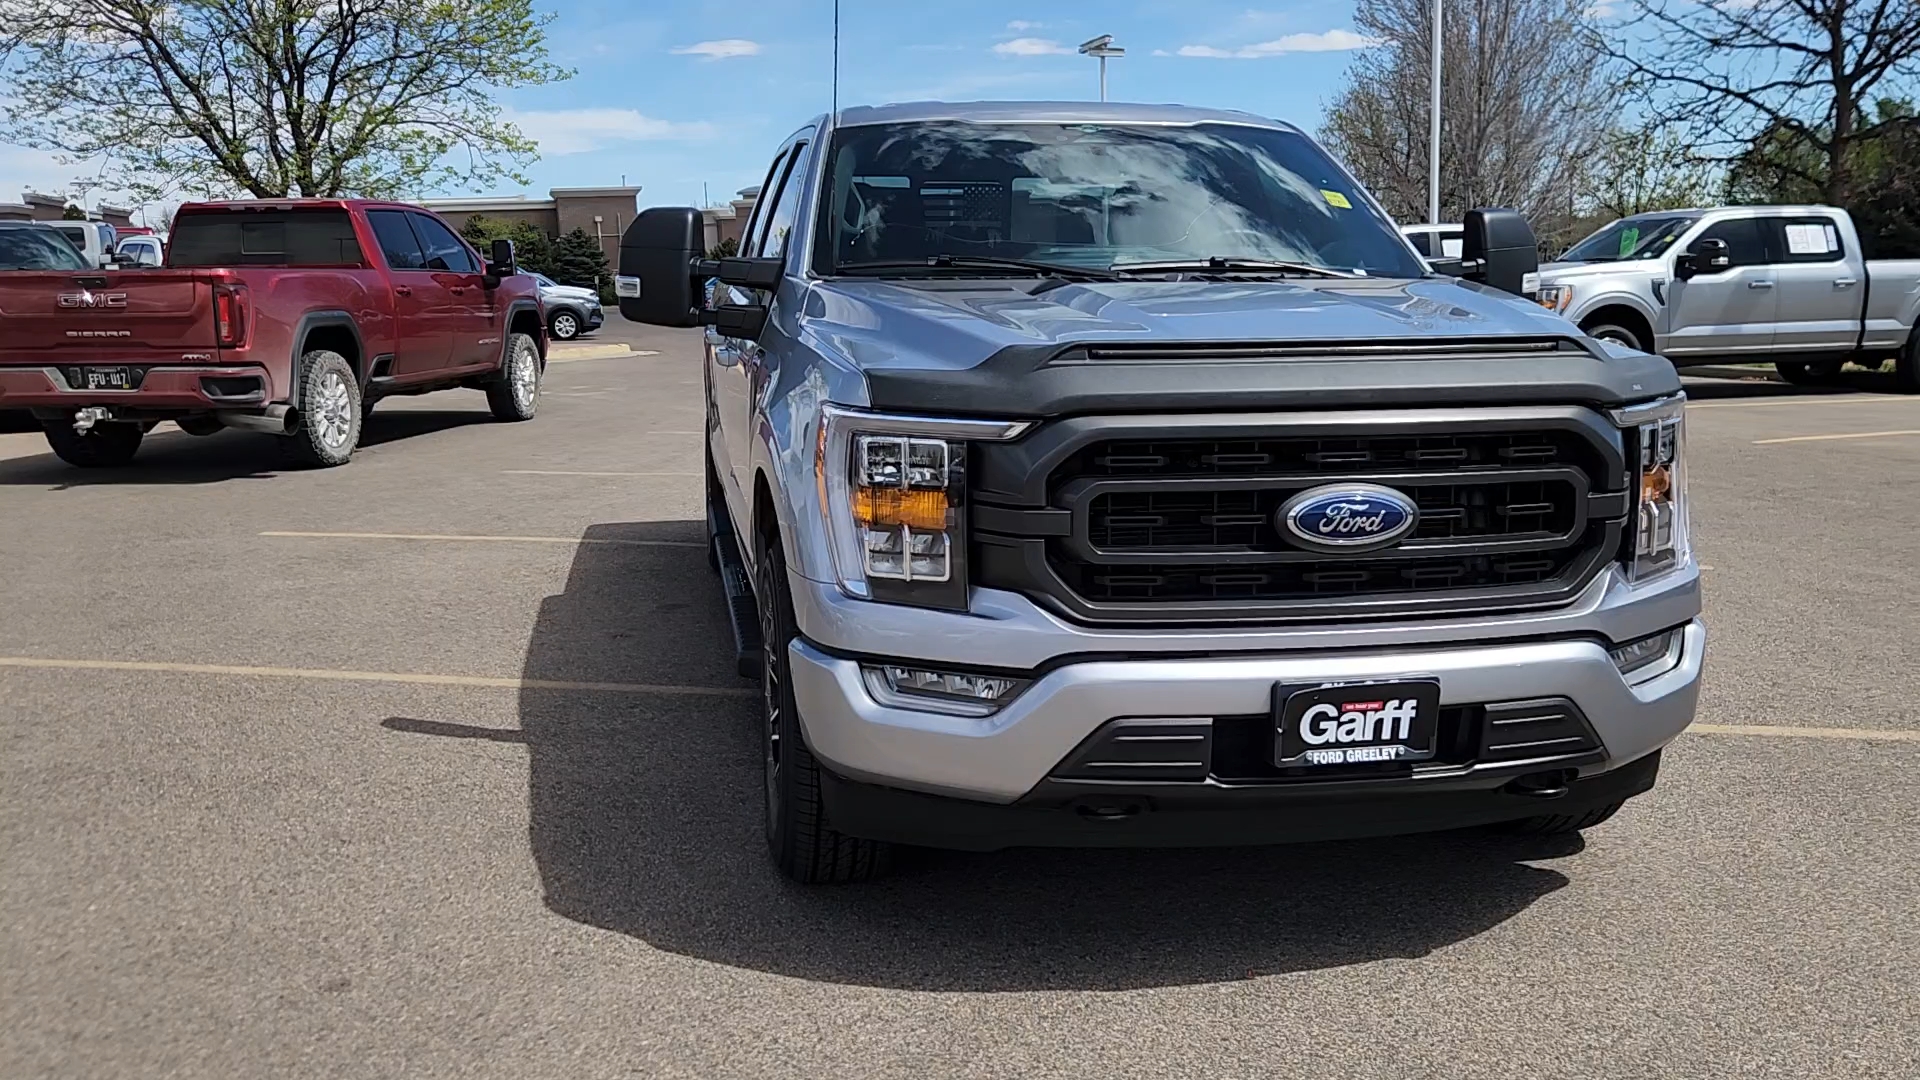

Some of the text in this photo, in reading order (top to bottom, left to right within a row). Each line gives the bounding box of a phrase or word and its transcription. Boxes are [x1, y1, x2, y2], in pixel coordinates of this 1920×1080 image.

[57, 293, 127, 308] GMC
[1319, 502, 1386, 533] Ford
[1300, 700, 1418, 745] Garff
[1313, 747, 1397, 765] FORD GREELEY
